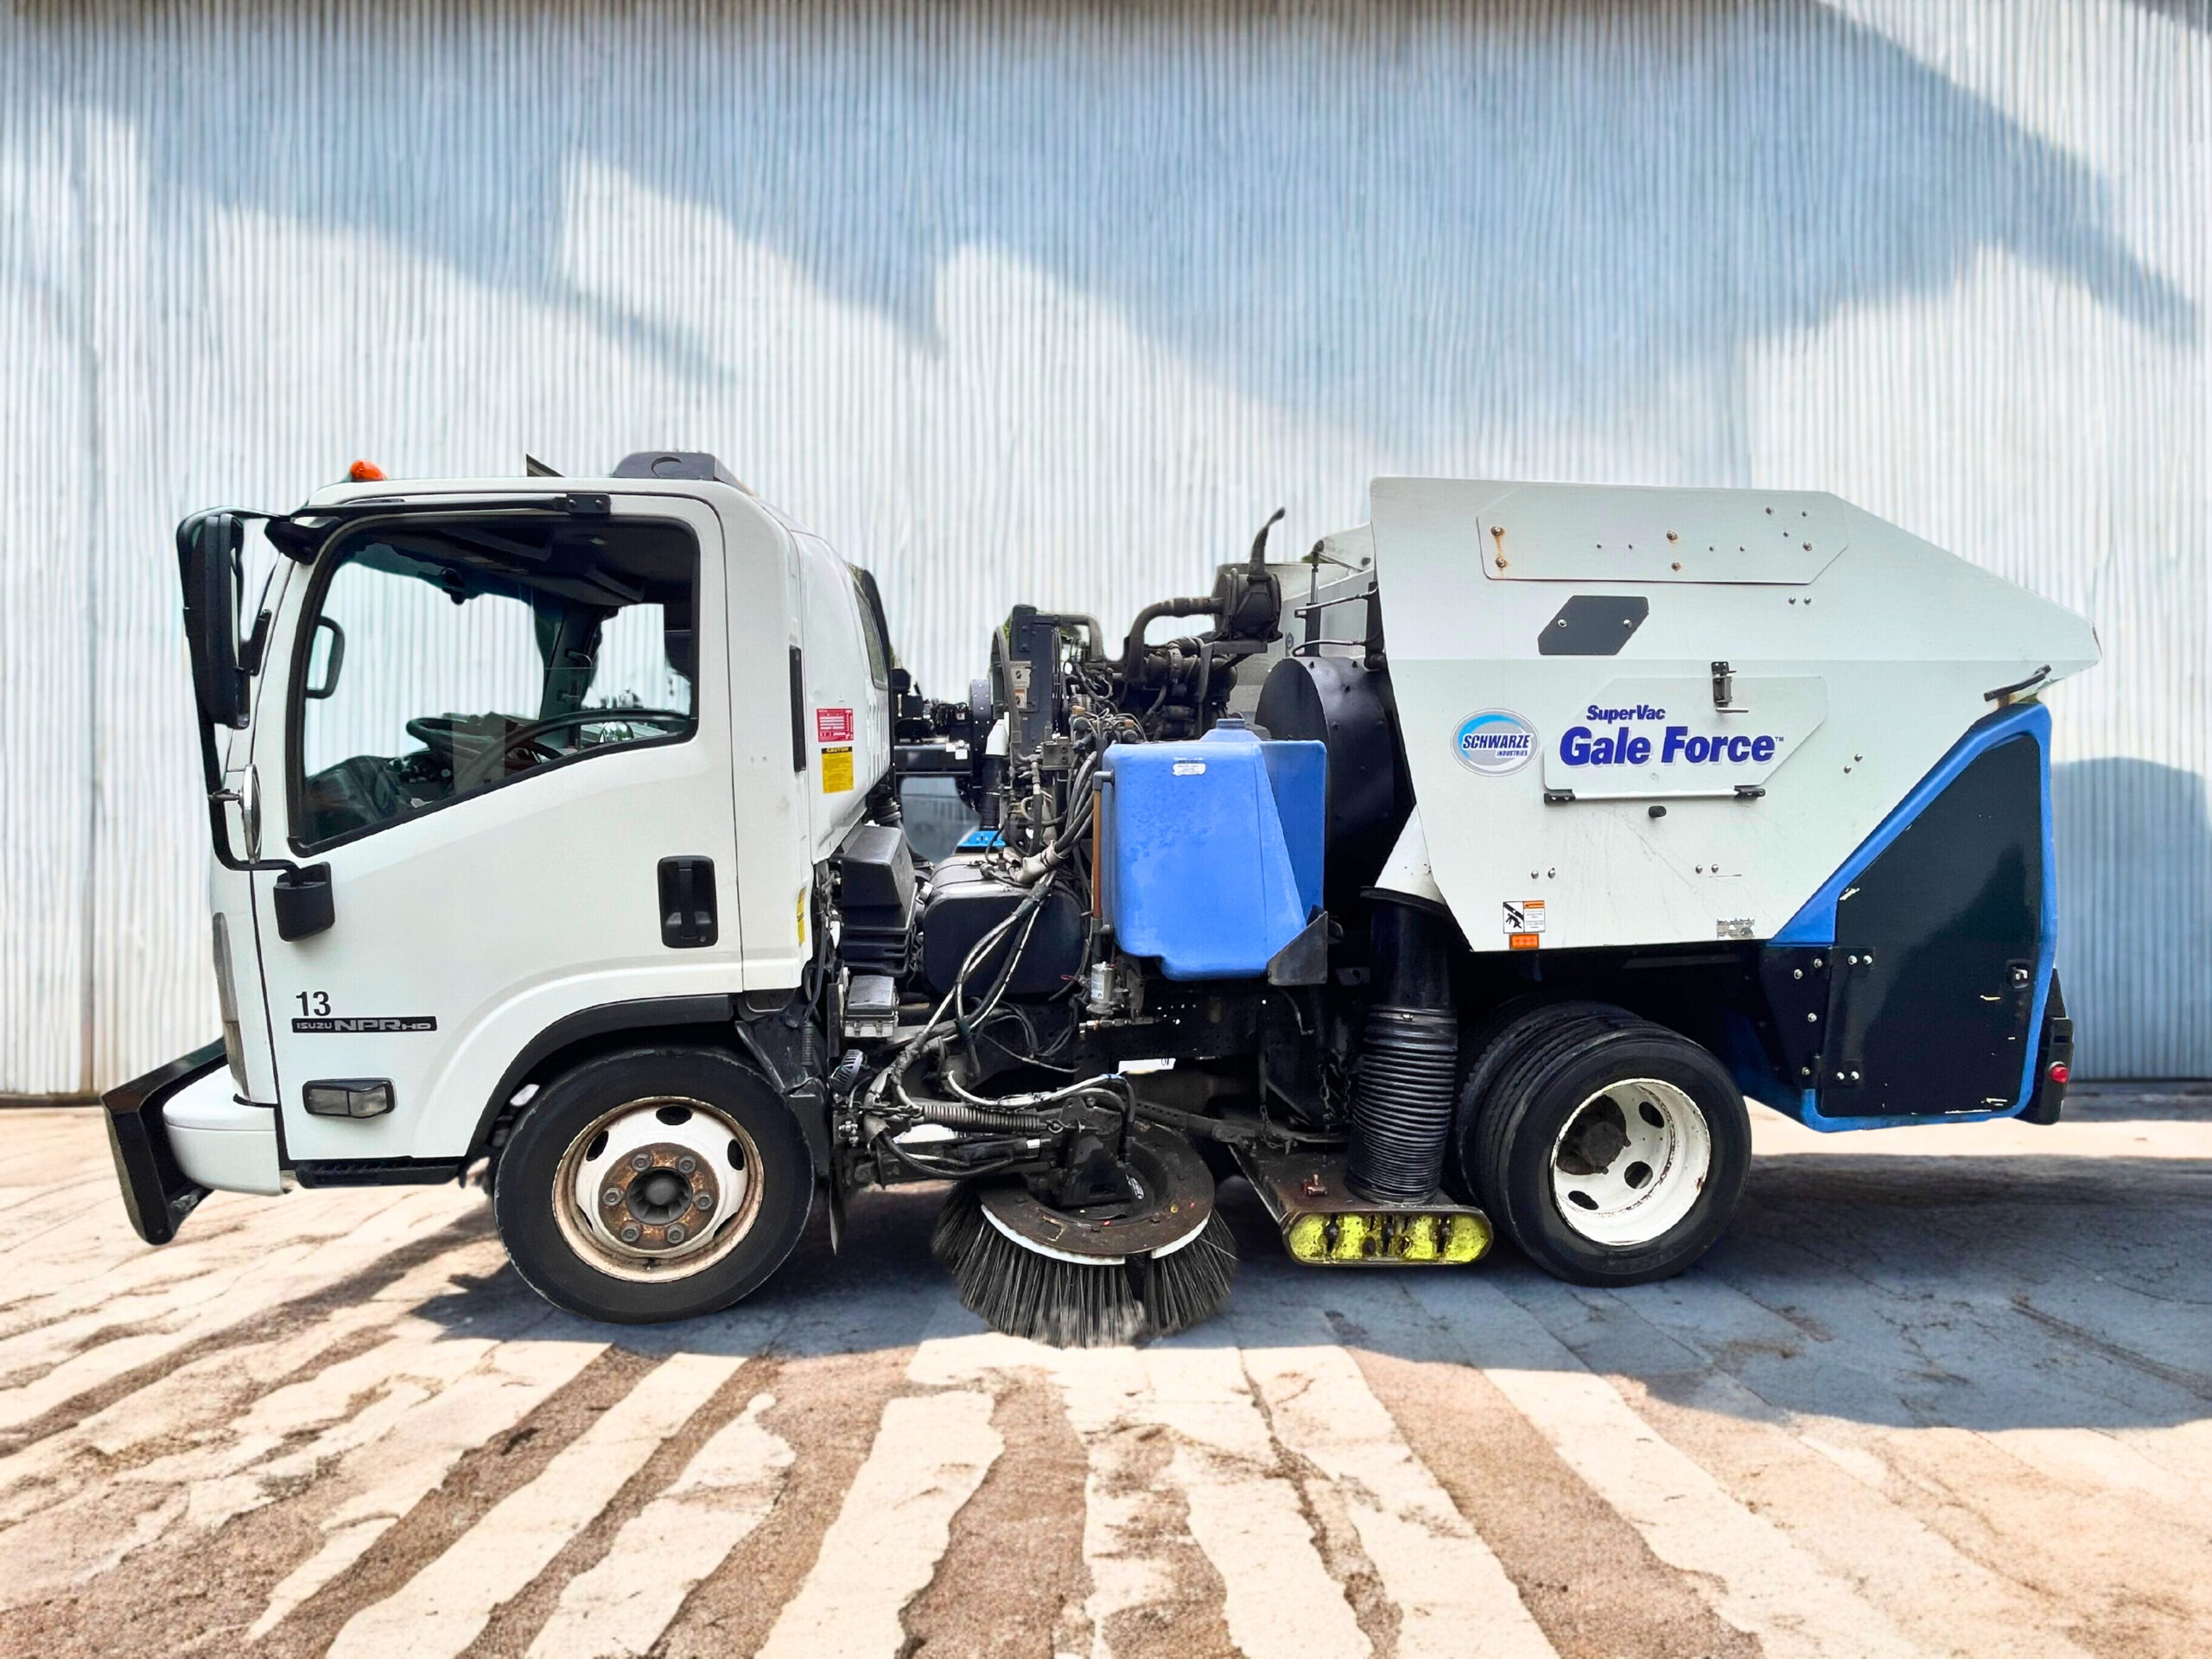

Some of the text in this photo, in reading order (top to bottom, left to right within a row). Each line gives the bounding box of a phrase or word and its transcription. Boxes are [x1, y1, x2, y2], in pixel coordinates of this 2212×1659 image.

[1586, 704, 1666, 724] SuperVac
[1462, 734, 1530, 749] SCHWARZE
[1560, 726, 1652, 766] Gale
[1661, 725, 1777, 764] Force
[296, 990, 332, 1017] 13
